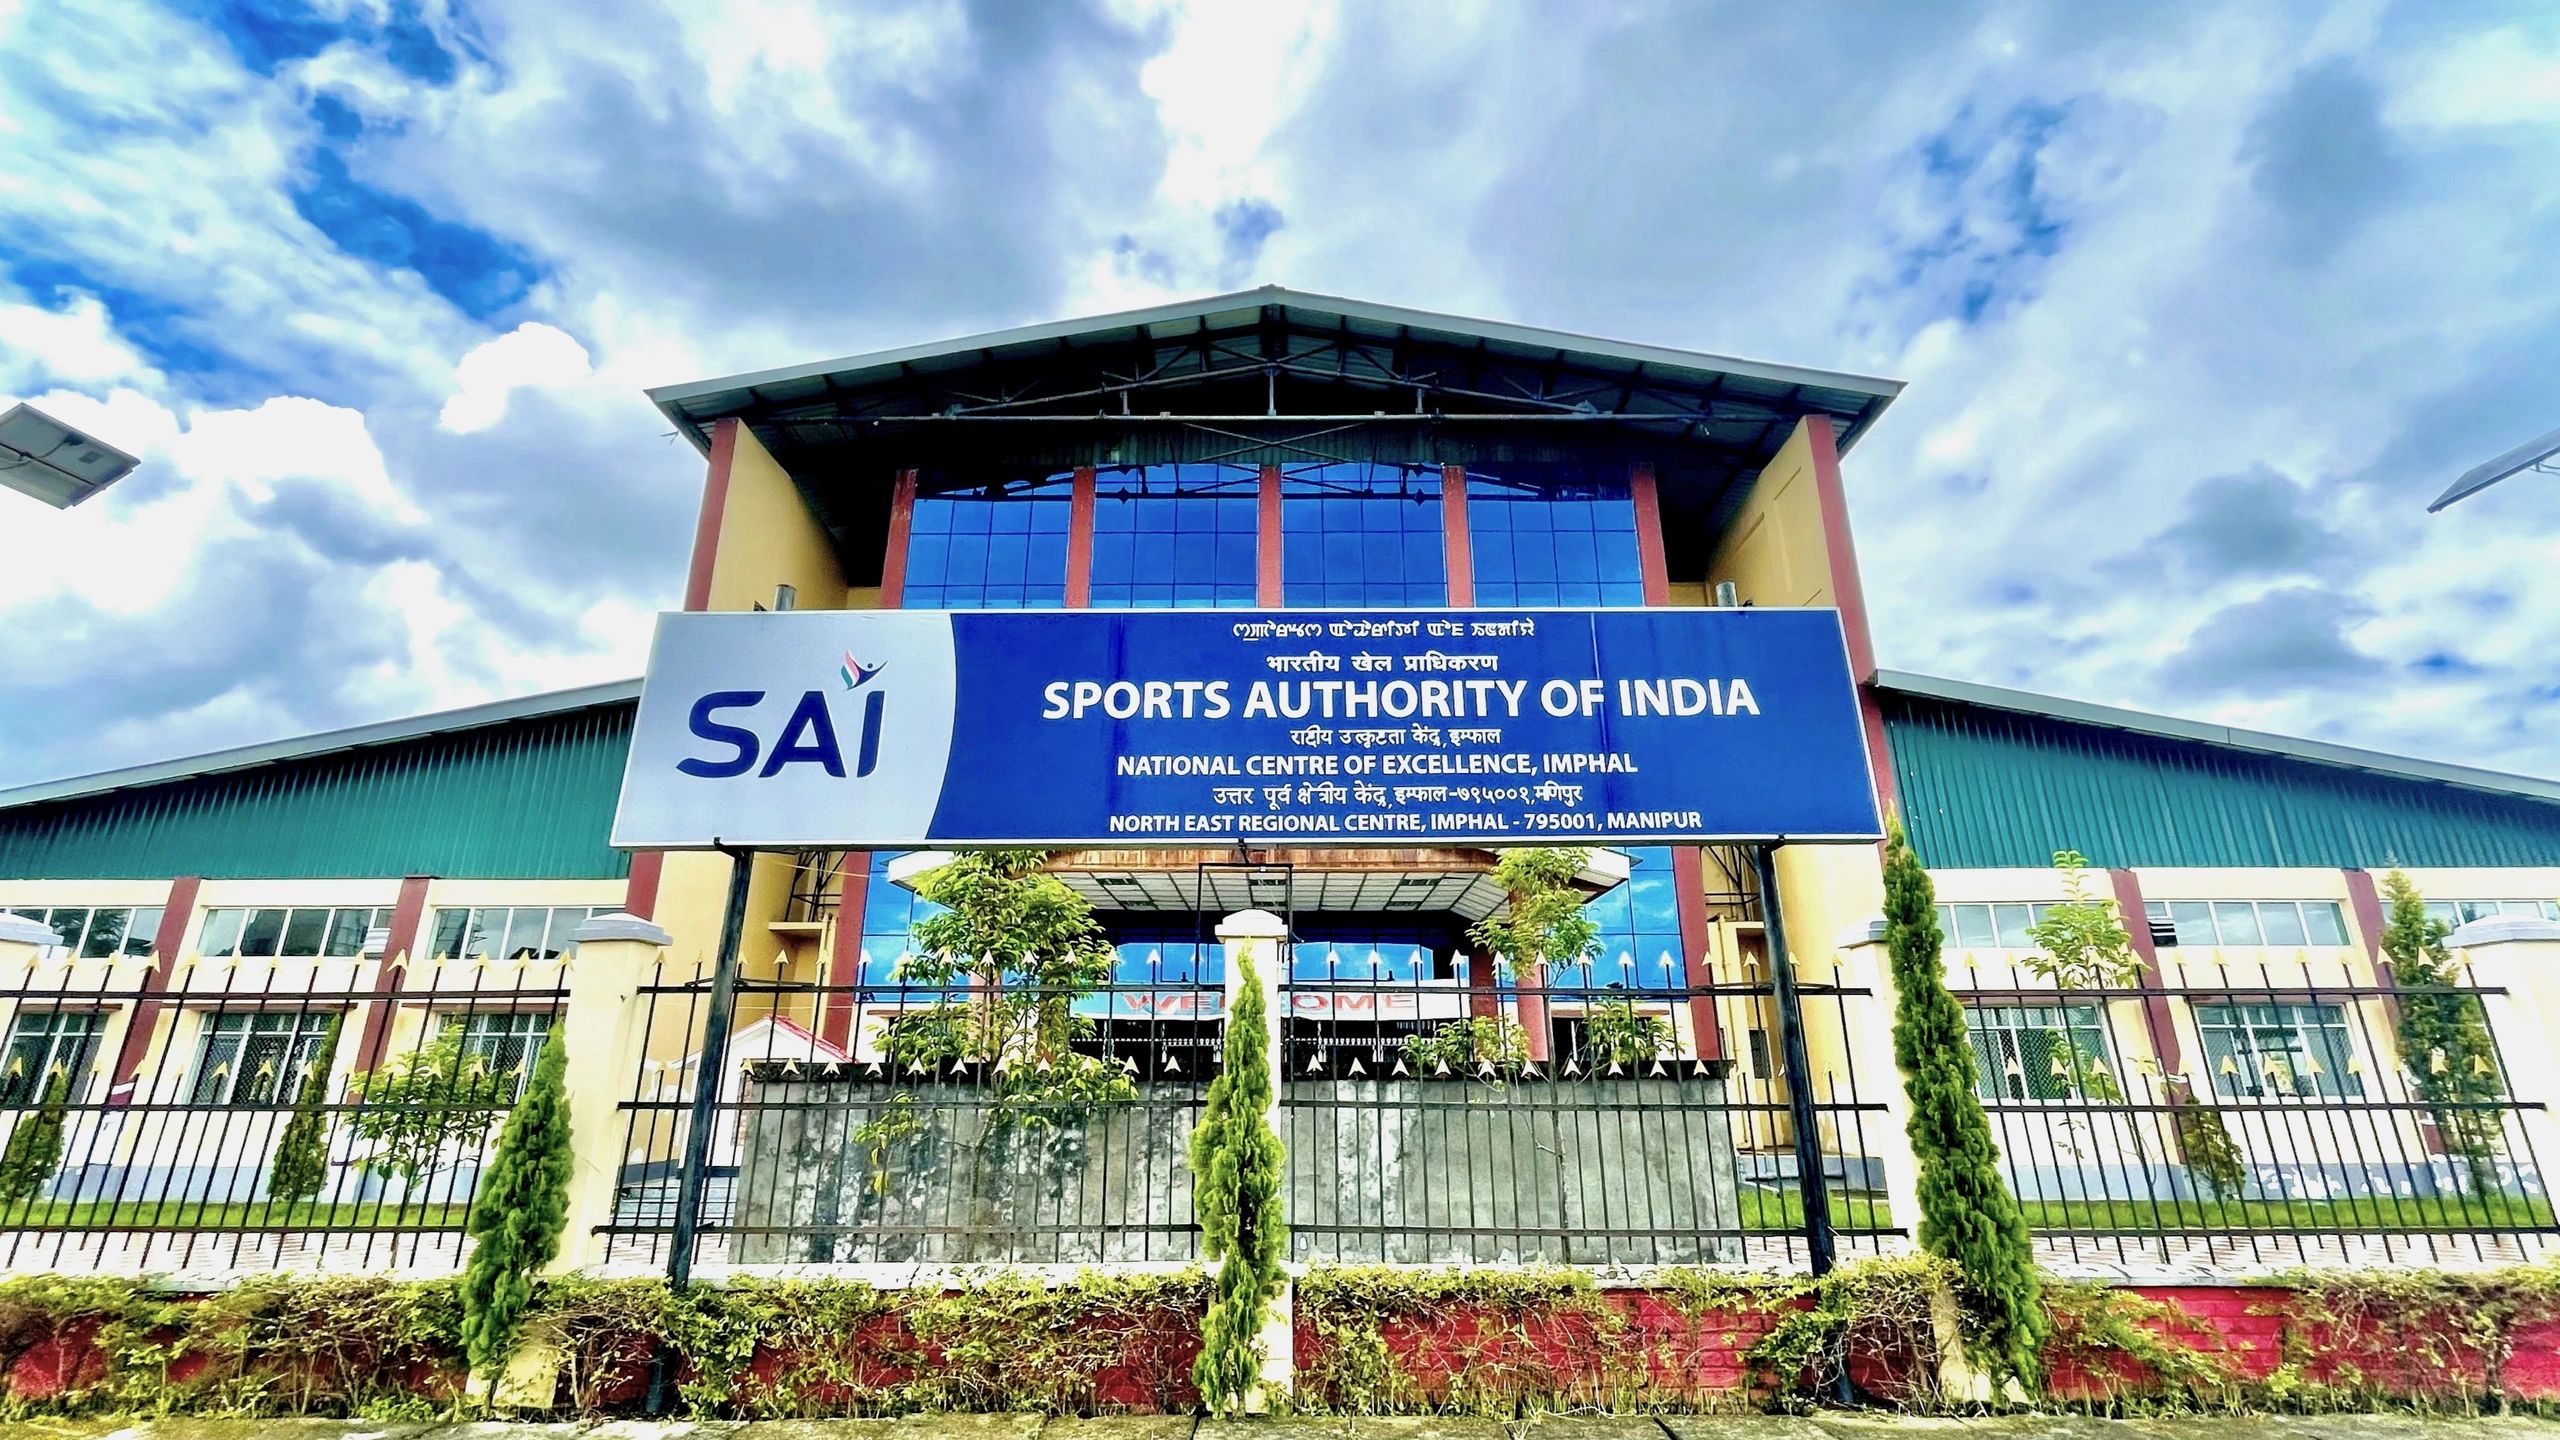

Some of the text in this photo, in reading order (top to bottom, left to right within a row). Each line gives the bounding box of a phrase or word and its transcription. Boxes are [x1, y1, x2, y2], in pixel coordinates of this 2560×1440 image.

[1266, 650, 1499, 673] भारतीय खेल प्राधिकरण
[1042, 678, 1761, 720] SPORTS AUTHORITY OF INDIA
[676, 690, 885, 779] SAI
[1117, 753, 1639, 777] NATIONAL CENTRE OF EXCELLENCE, IMPHAL
[1212, 787, 1255, 805] उत्तर
[1262, 783, 1293, 811] पूर्व
[1109, 814, 1180, 832] NORTH
[1184, 814, 1235, 832] EAST
[1238, 814, 1341, 832] REGIONAL
[1344, 813, 1427, 833] CENTRE,
[1430, 813, 1509, 831] IMPHAL
[1523, 813, 1603, 832] 795001,
[1607, 811, 1703, 830] MANIPUR
[1123, 994, 1416, 1011] WEOME
